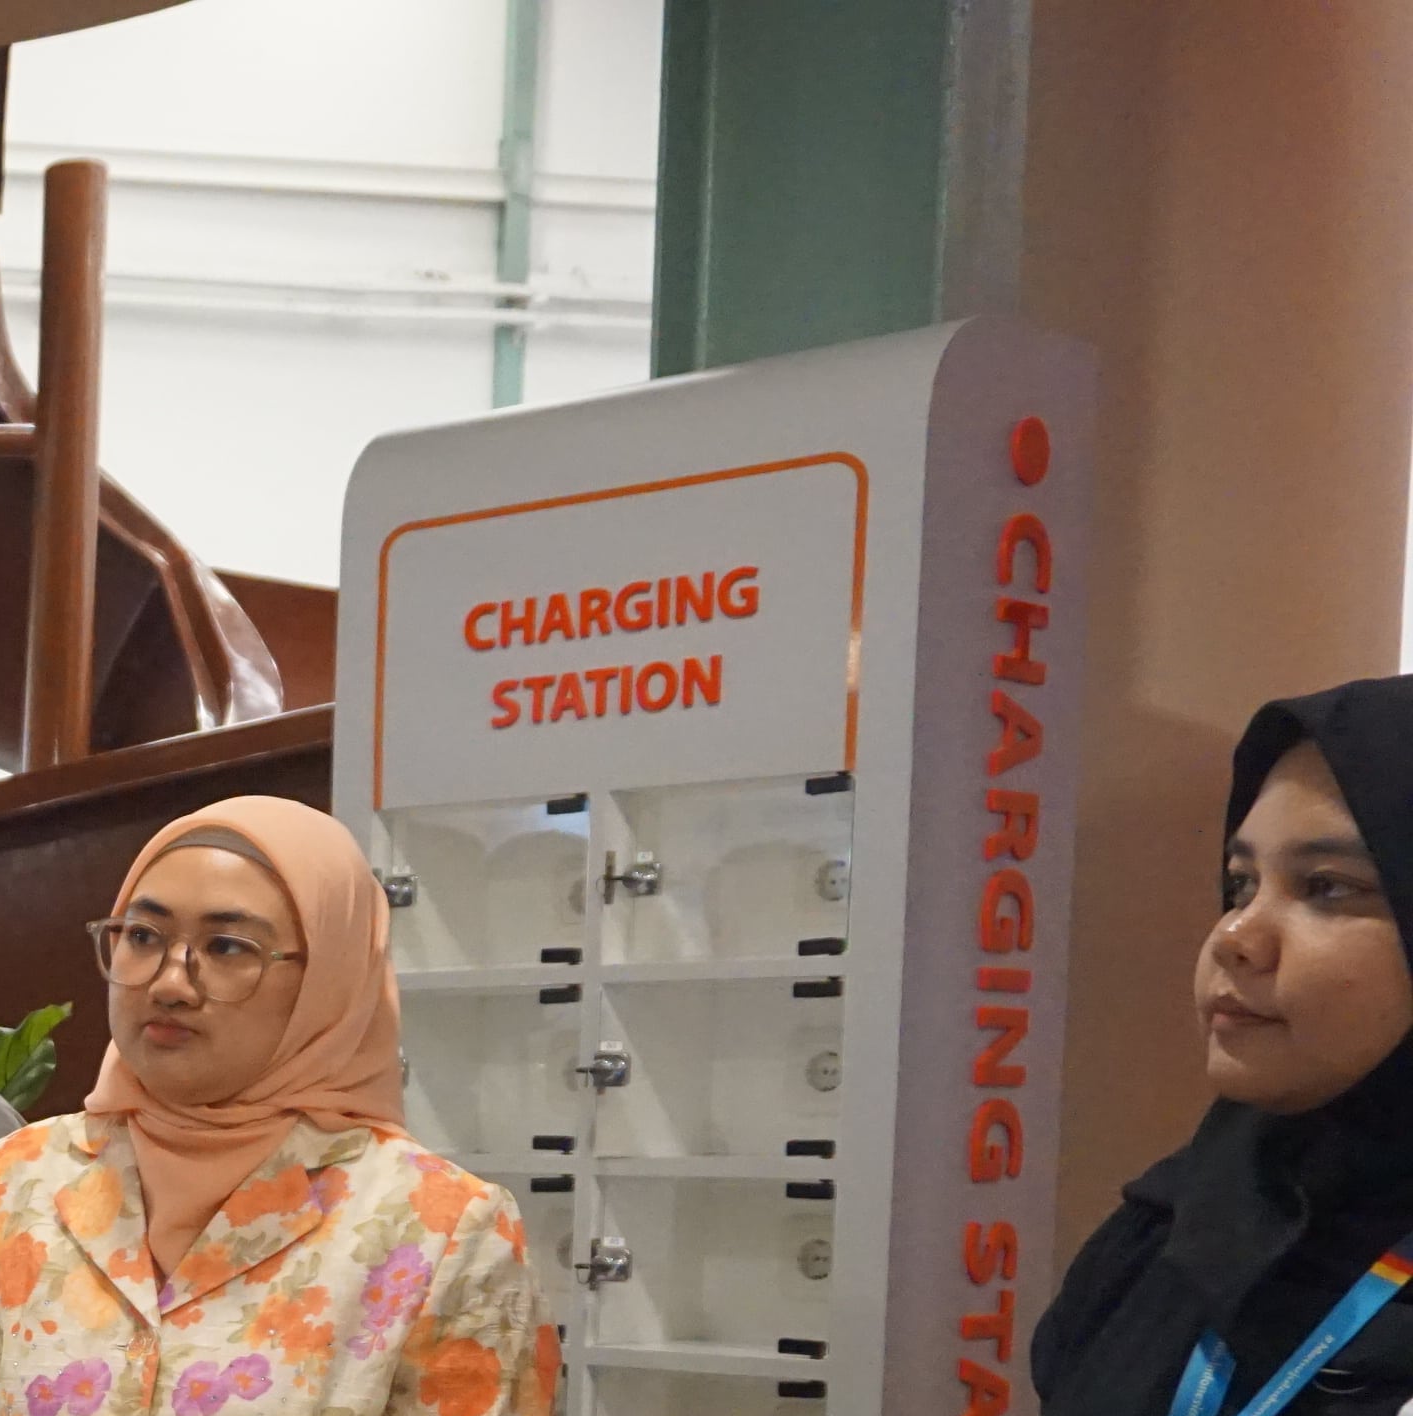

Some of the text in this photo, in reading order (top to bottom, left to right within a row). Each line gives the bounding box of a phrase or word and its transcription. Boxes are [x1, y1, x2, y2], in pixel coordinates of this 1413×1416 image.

[463, 566, 760, 652] CHARGING
[488, 654, 724, 730] STATION
[968, 513, 1053, 1184] CHARGING
